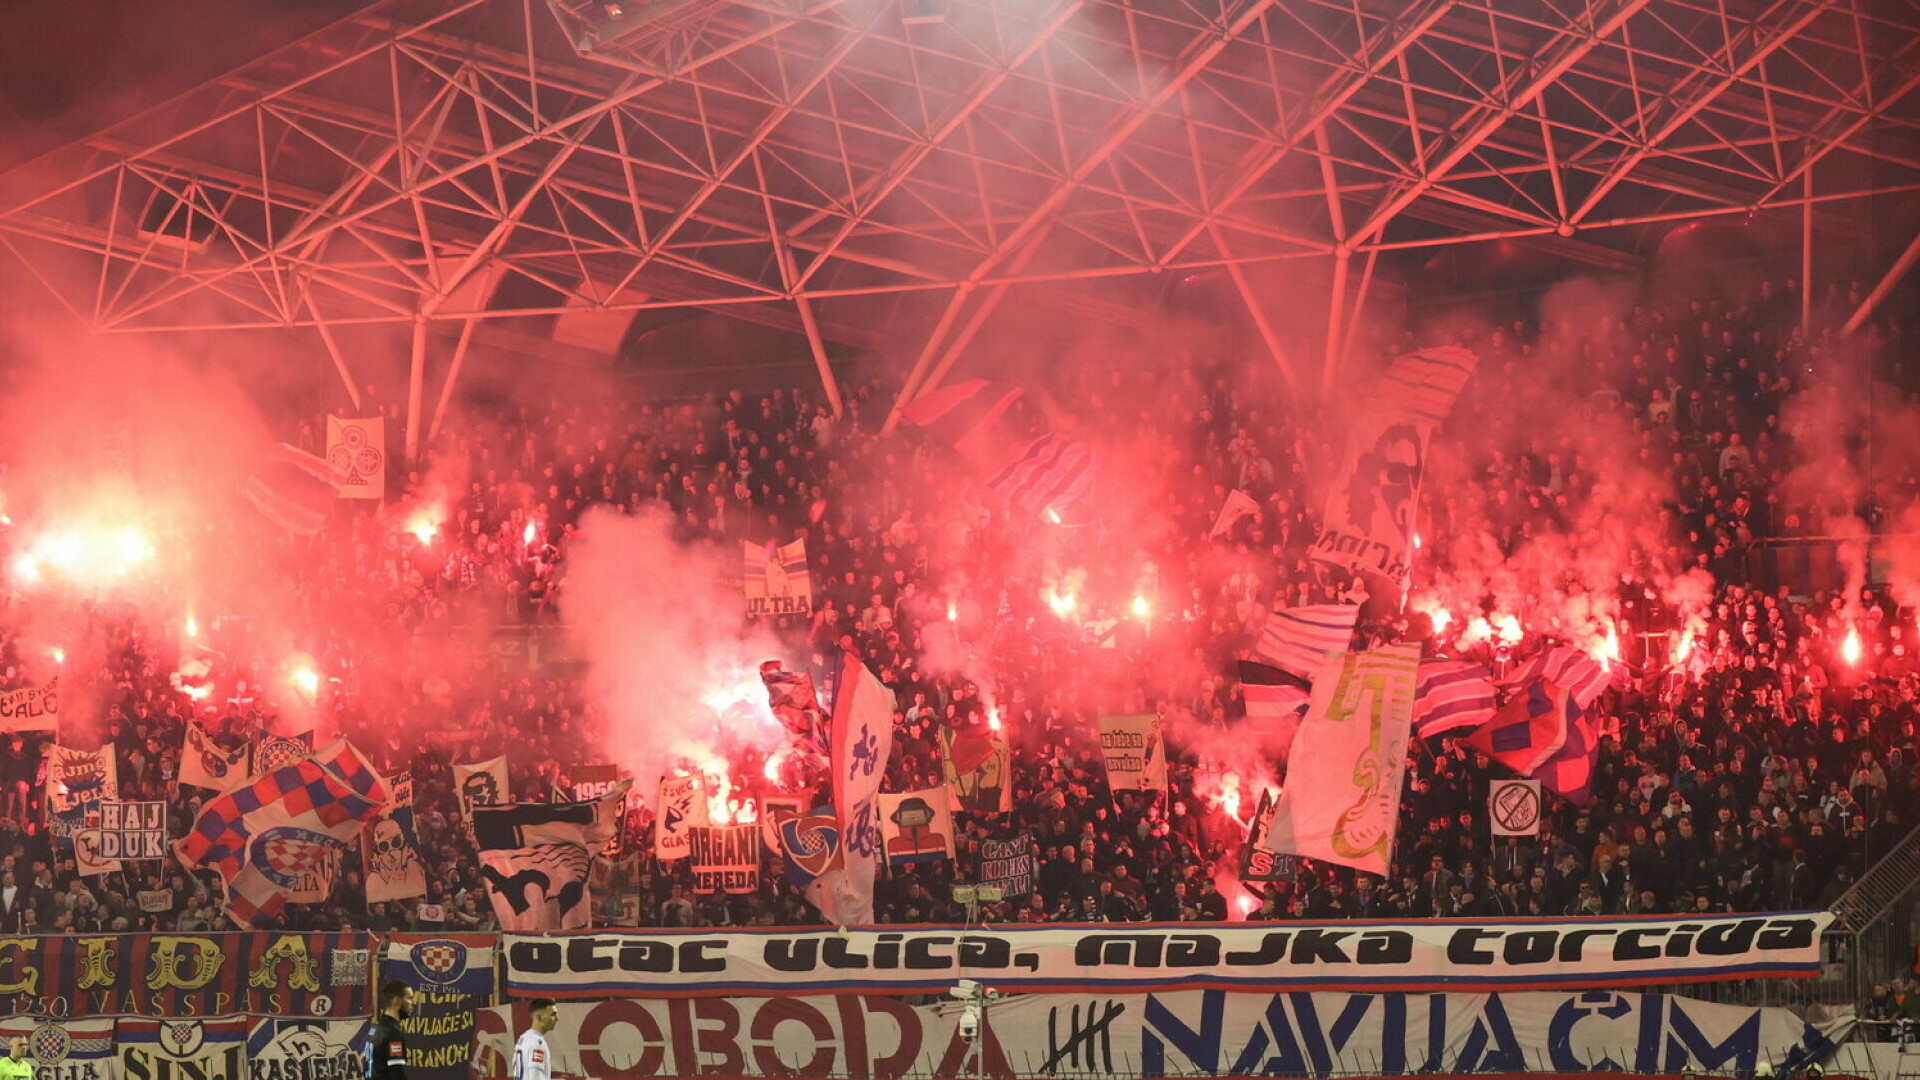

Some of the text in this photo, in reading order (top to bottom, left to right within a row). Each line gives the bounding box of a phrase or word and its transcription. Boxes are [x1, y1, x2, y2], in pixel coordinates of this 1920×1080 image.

[748, 595, 810, 613] ULTRA
[102, 803, 161, 830] HAJ
[102, 831, 163, 857] DUK
